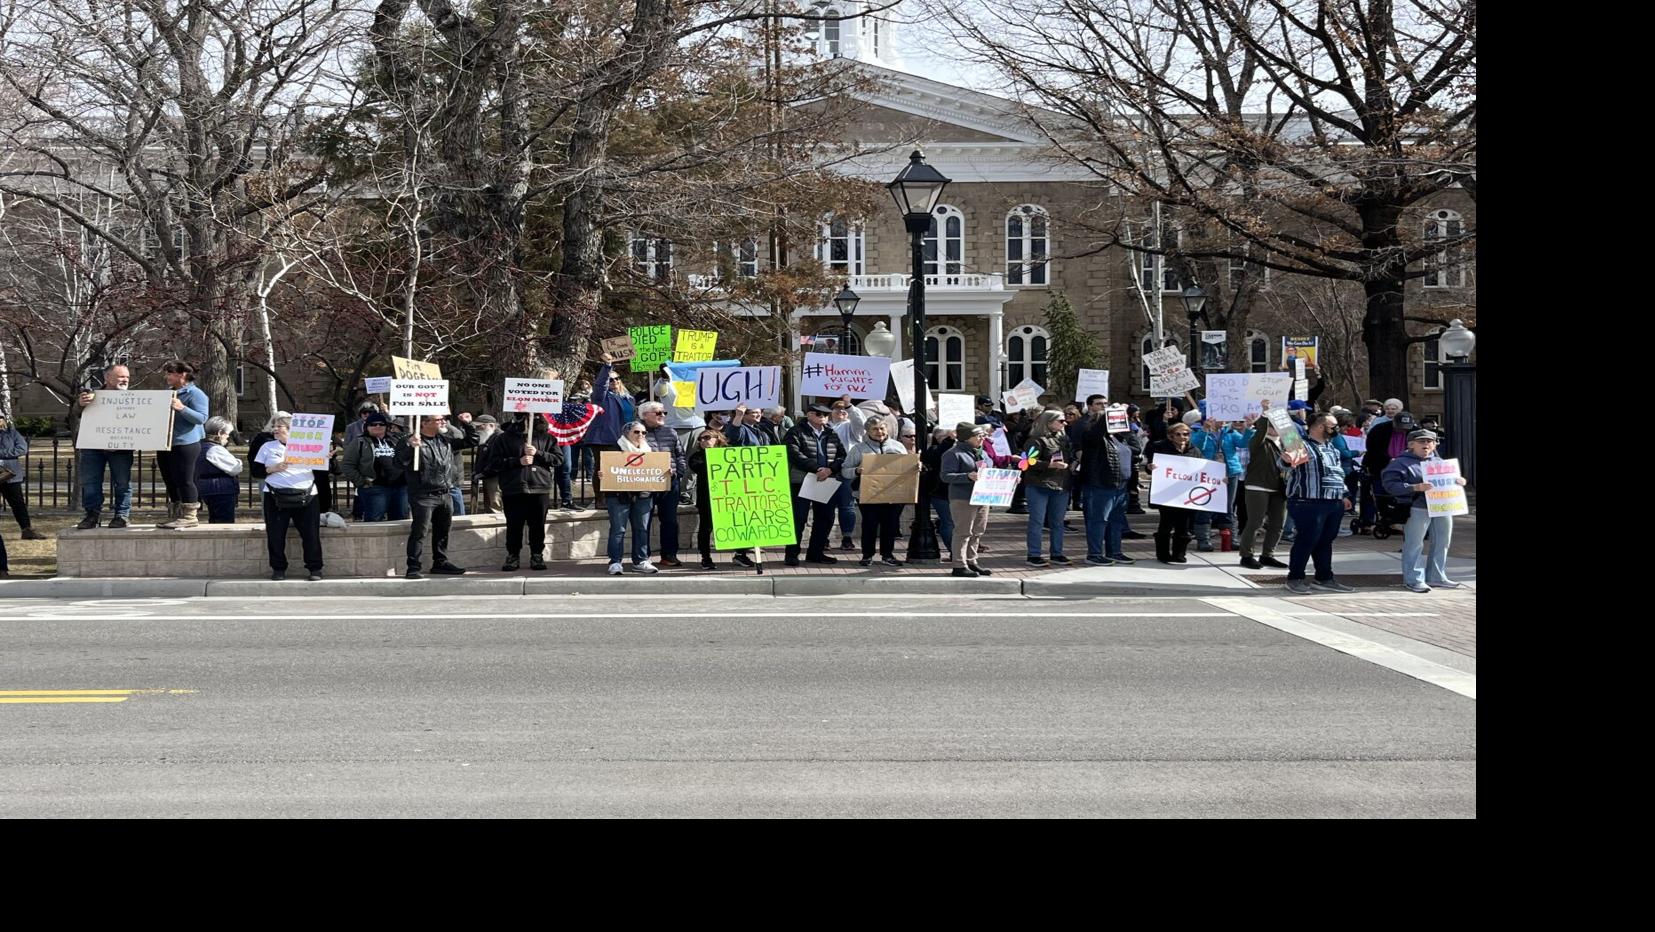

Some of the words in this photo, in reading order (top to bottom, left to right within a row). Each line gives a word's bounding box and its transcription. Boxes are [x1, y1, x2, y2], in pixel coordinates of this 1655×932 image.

[630, 326, 666, 337] POLICE
[680, 330, 715, 342] TRUMP
[631, 335, 657, 345] DIED
[675, 351, 712, 361] TRAITOR
[699, 368, 776, 404] UGH!
[1209, 403, 1240, 417] PRO
[292, 418, 325, 428] STOP
[95, 427, 152, 435] RESISTANCE
[710, 461, 780, 480] PARTY
[712, 493, 791, 512] TRAITORS
[732, 509, 789, 527] LIARS
[715, 523, 792, 543] COWARDS
